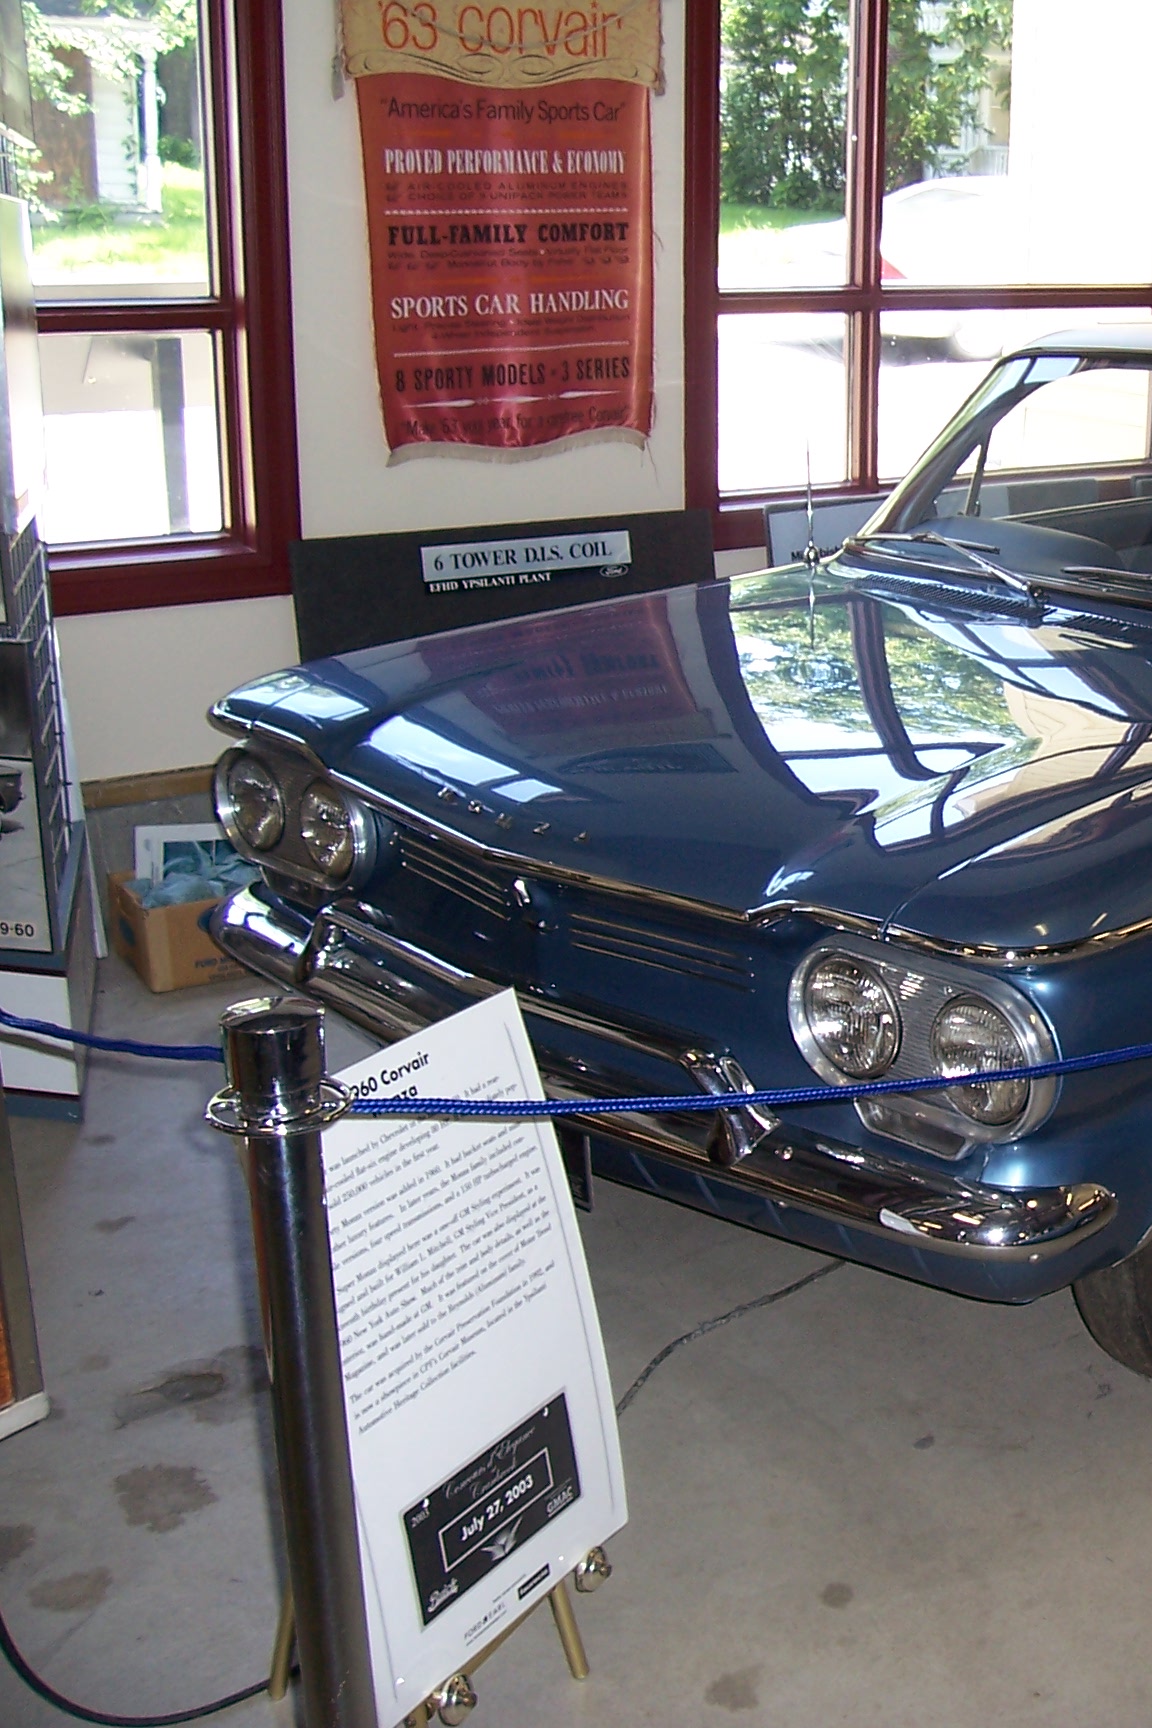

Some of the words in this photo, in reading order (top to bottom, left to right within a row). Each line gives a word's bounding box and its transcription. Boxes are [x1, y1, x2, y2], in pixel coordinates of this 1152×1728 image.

[458, 2, 622, 56] corvair
[477, 100, 533, 123] Family
[539, 101, 589, 124] Sports
[384, 149, 443, 174] PROVED
[448, 150, 548, 174] PERFORMANCE
[553, 152, 563, 173] &
[567, 150, 626, 174] ECONOMY
[387, 223, 527, 246] FULL-FAMILY
[538, 222, 629, 243] COMFORT
[391, 296, 468, 319] SPORTS
[475, 293, 521, 315] CAR
[529, 289, 629, 313] HANDLING
[395, 369, 405, 392] 8
[414, 366, 473, 391] SPORTY
[482, 362, 546, 386] MODELS
[562, 361, 569, 382] 3
[576, 357, 630, 380] SERIES
[433, 555, 443, 571] 6
[450, 548, 518, 571] TOWER
[525, 544, 564, 564] D.I.S.
[569, 541, 612, 560] COIL
[462, 576, 516, 591] YPSILANTI
[519, 572, 552, 584] PLANT
[350, 1077, 378, 1100] 960
[381, 1051, 430, 1086] Corvair
[461, 1514, 484, 1541] July
[486, 1499, 504, 1521] 27,
[506, 1474, 534, 1504] 2003
